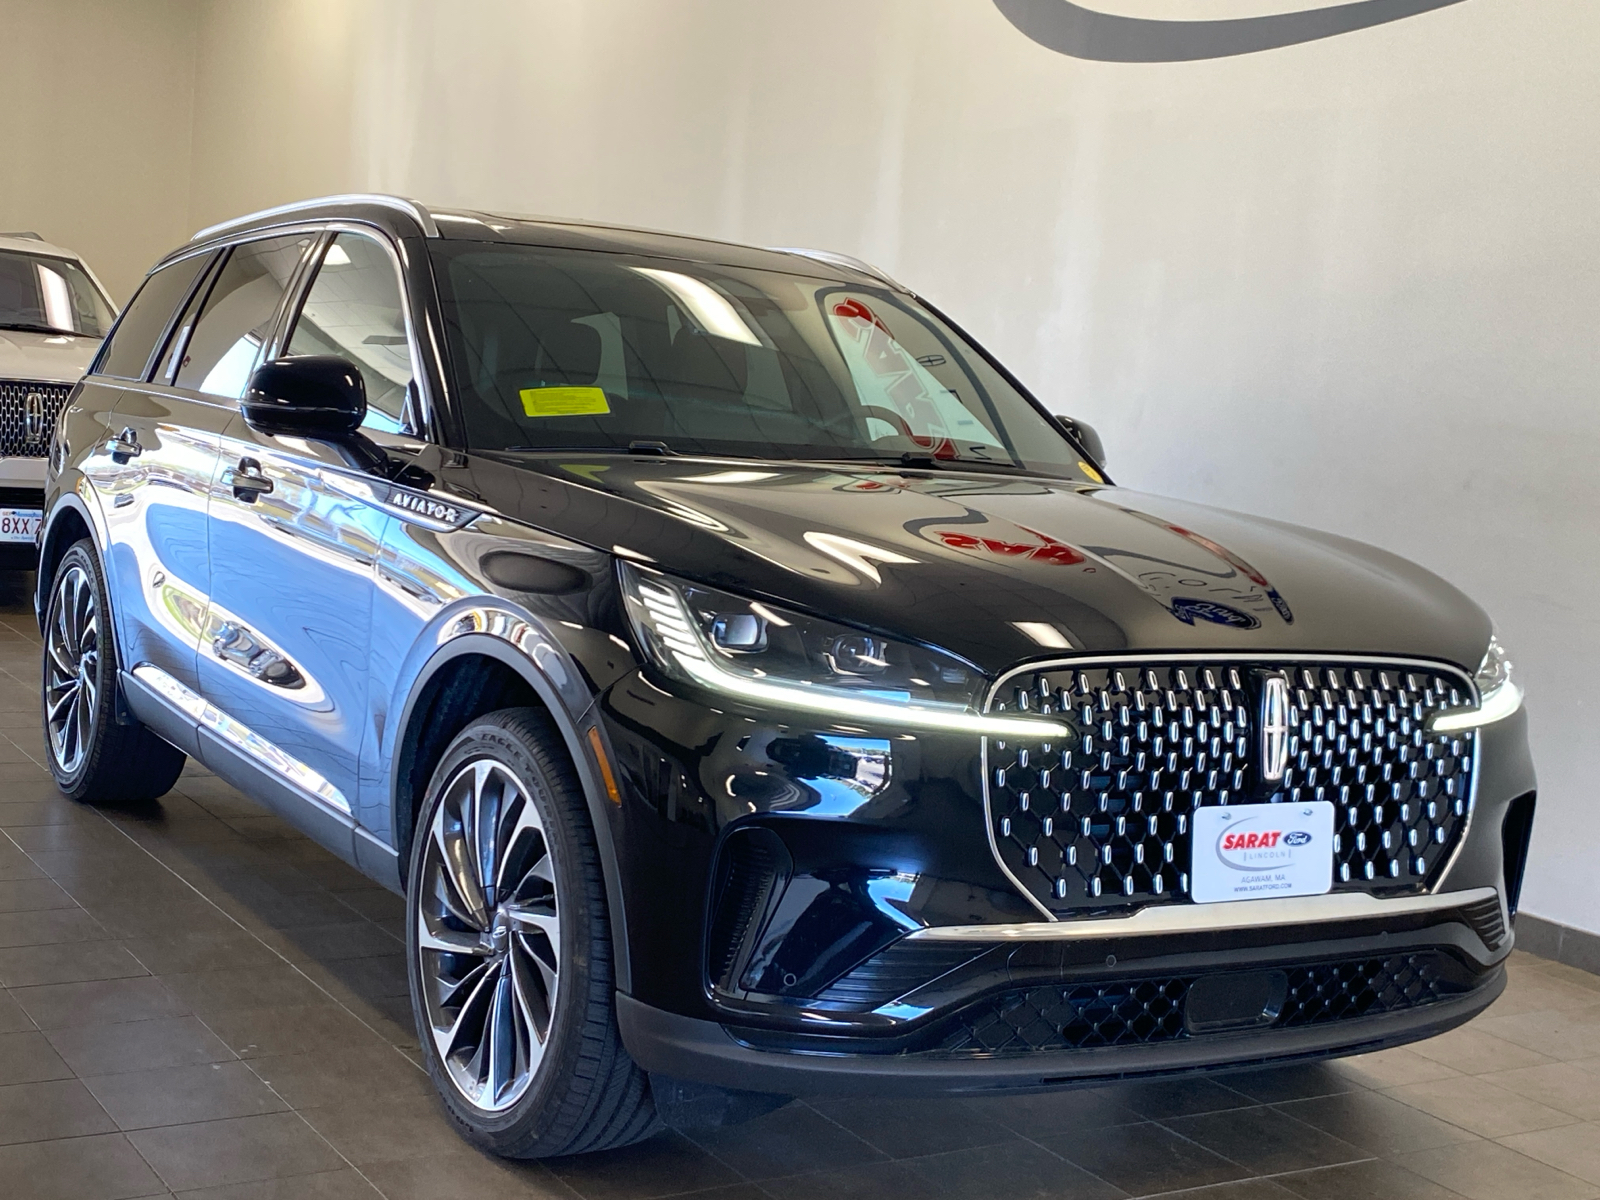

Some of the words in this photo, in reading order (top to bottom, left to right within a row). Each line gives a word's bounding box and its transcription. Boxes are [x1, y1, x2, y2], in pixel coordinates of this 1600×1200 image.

[393, 493, 459, 523] AVIATOR
[2, 517, 29, 534] 8XX
[1222, 830, 1282, 852] SARAT
[1286, 831, 1308, 845] Ford
[1249, 851, 1286, 860] LINCOLN
[1241, 875, 1273, 884] AGAWAM,
[1274, 874, 1286, 882] MA
[1233, 883, 1292, 893] WWW.SARATFORD.COM
